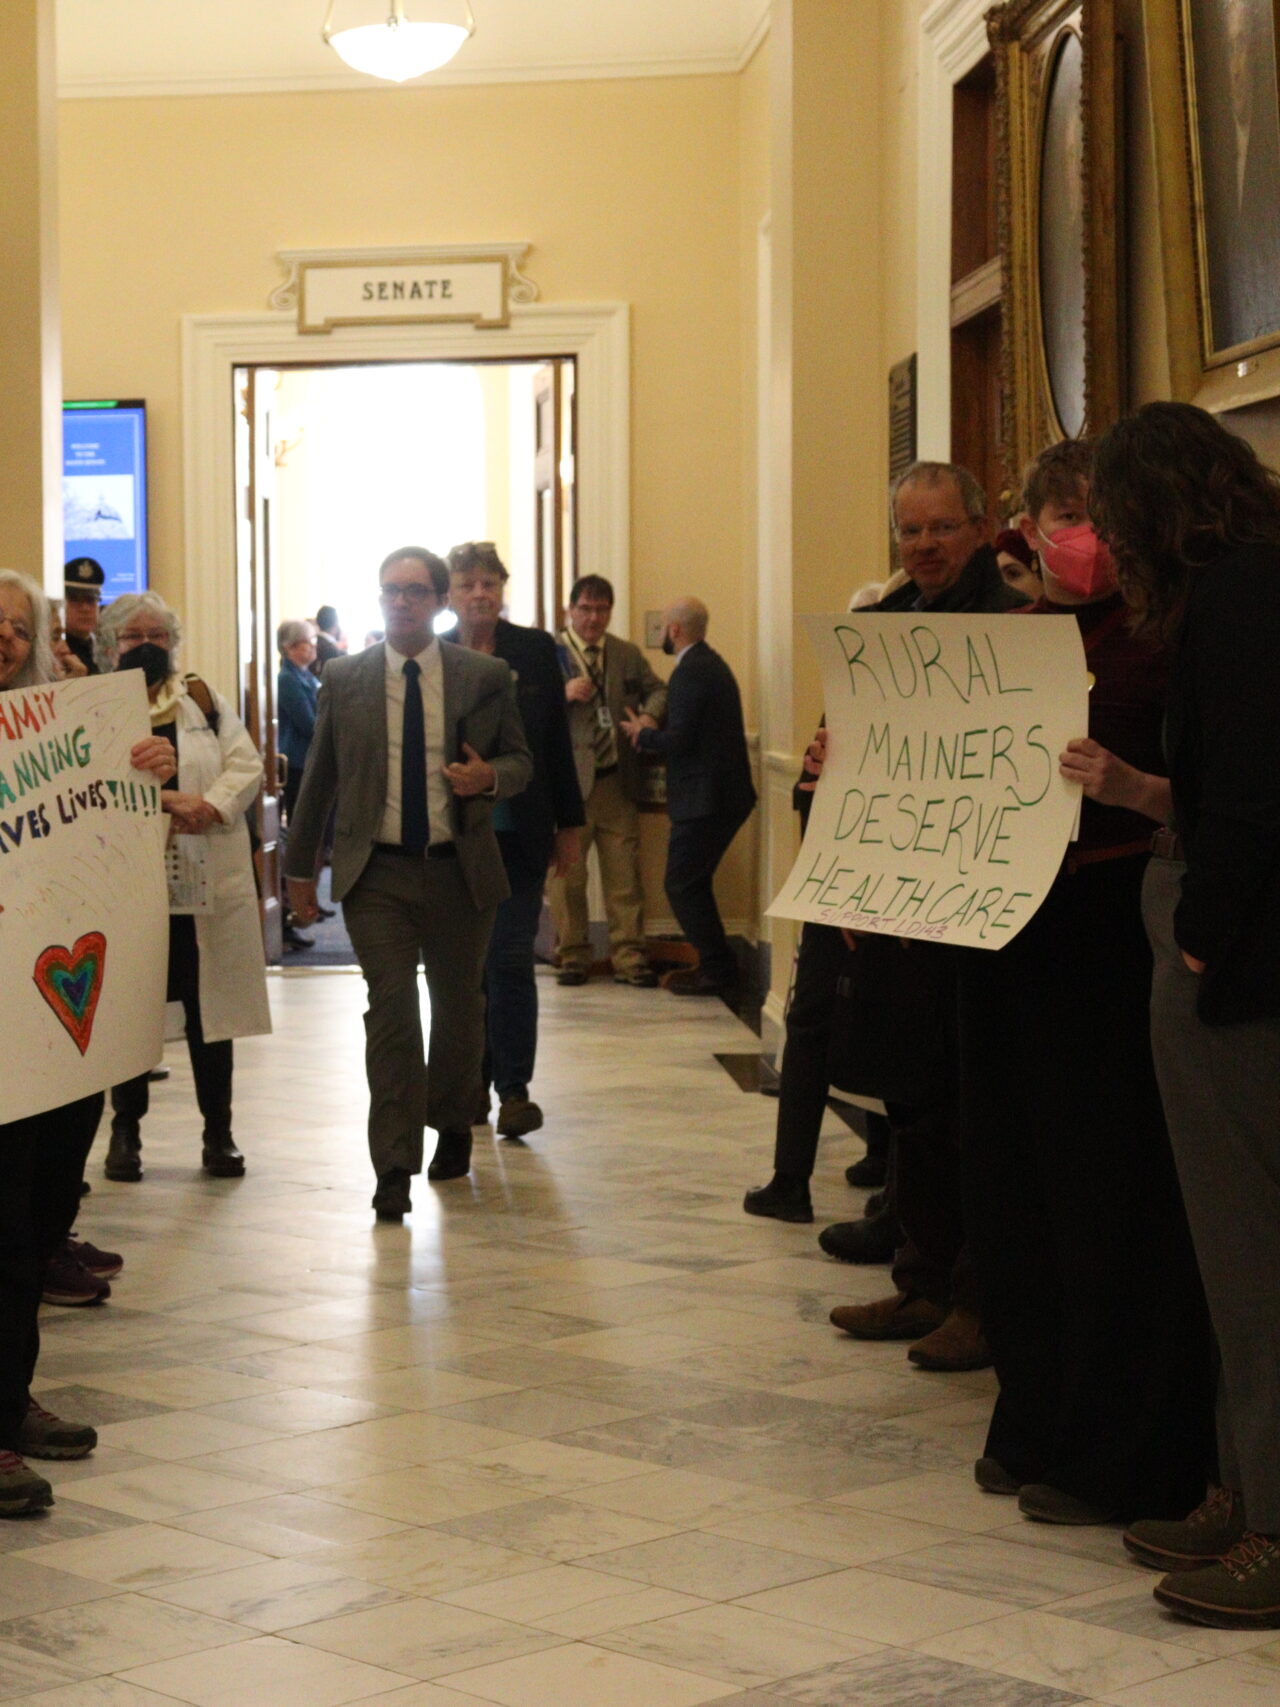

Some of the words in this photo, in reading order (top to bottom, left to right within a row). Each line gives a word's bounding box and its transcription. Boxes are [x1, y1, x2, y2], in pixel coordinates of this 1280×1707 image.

[362, 279, 453, 301] SENATE
[833, 625, 1033, 704] RURAL
[857, 722, 1052, 806] MAINERS
[833, 788, 1021, 875] DESERVE
[793, 852, 1033, 939] HEALTHCARE
[814, 908, 897, 930] SUPPORT
